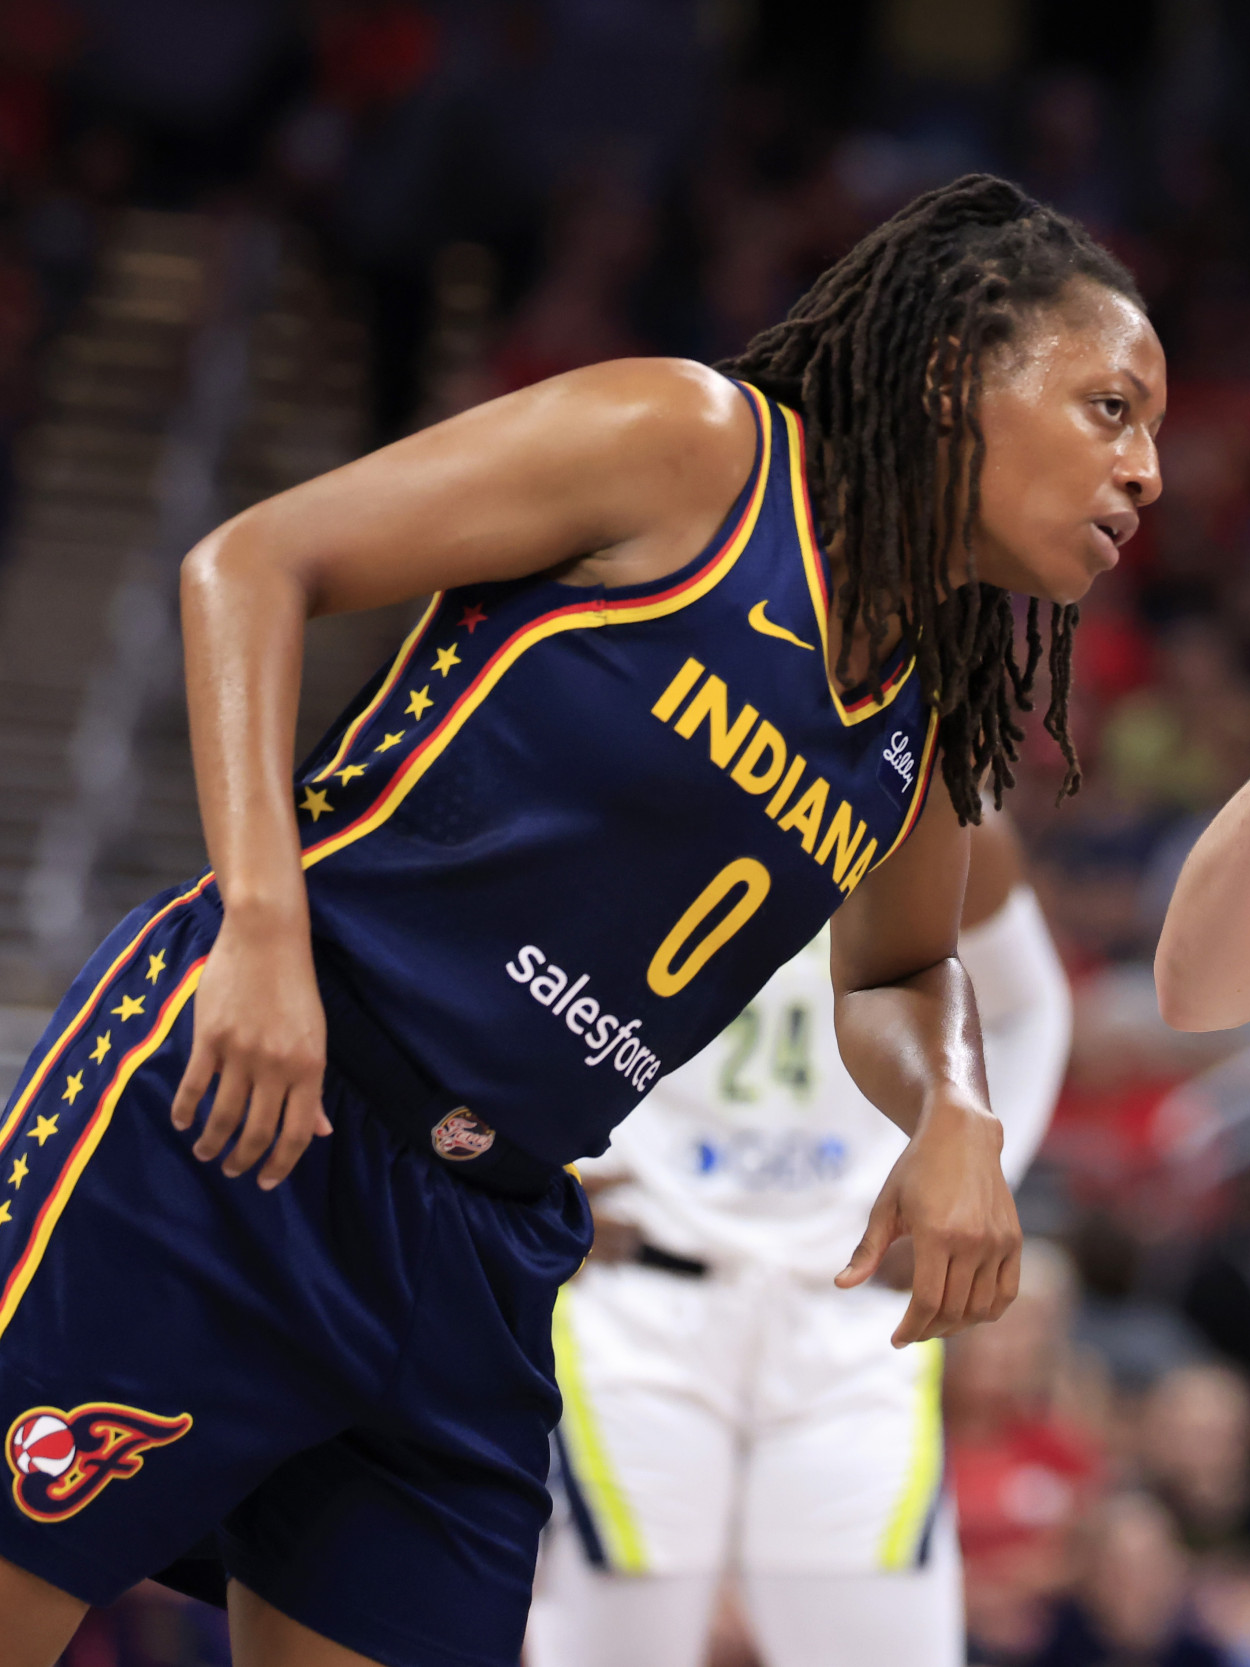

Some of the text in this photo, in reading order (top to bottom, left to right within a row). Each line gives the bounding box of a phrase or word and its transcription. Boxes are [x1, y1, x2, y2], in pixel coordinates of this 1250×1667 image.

[651, 657, 879, 899] INDIANA
[882, 731, 915, 793] Lilly
[647, 857, 771, 998] 0
[505, 945, 662, 1093] salesforce
[717, 1003, 813, 1103] 24
